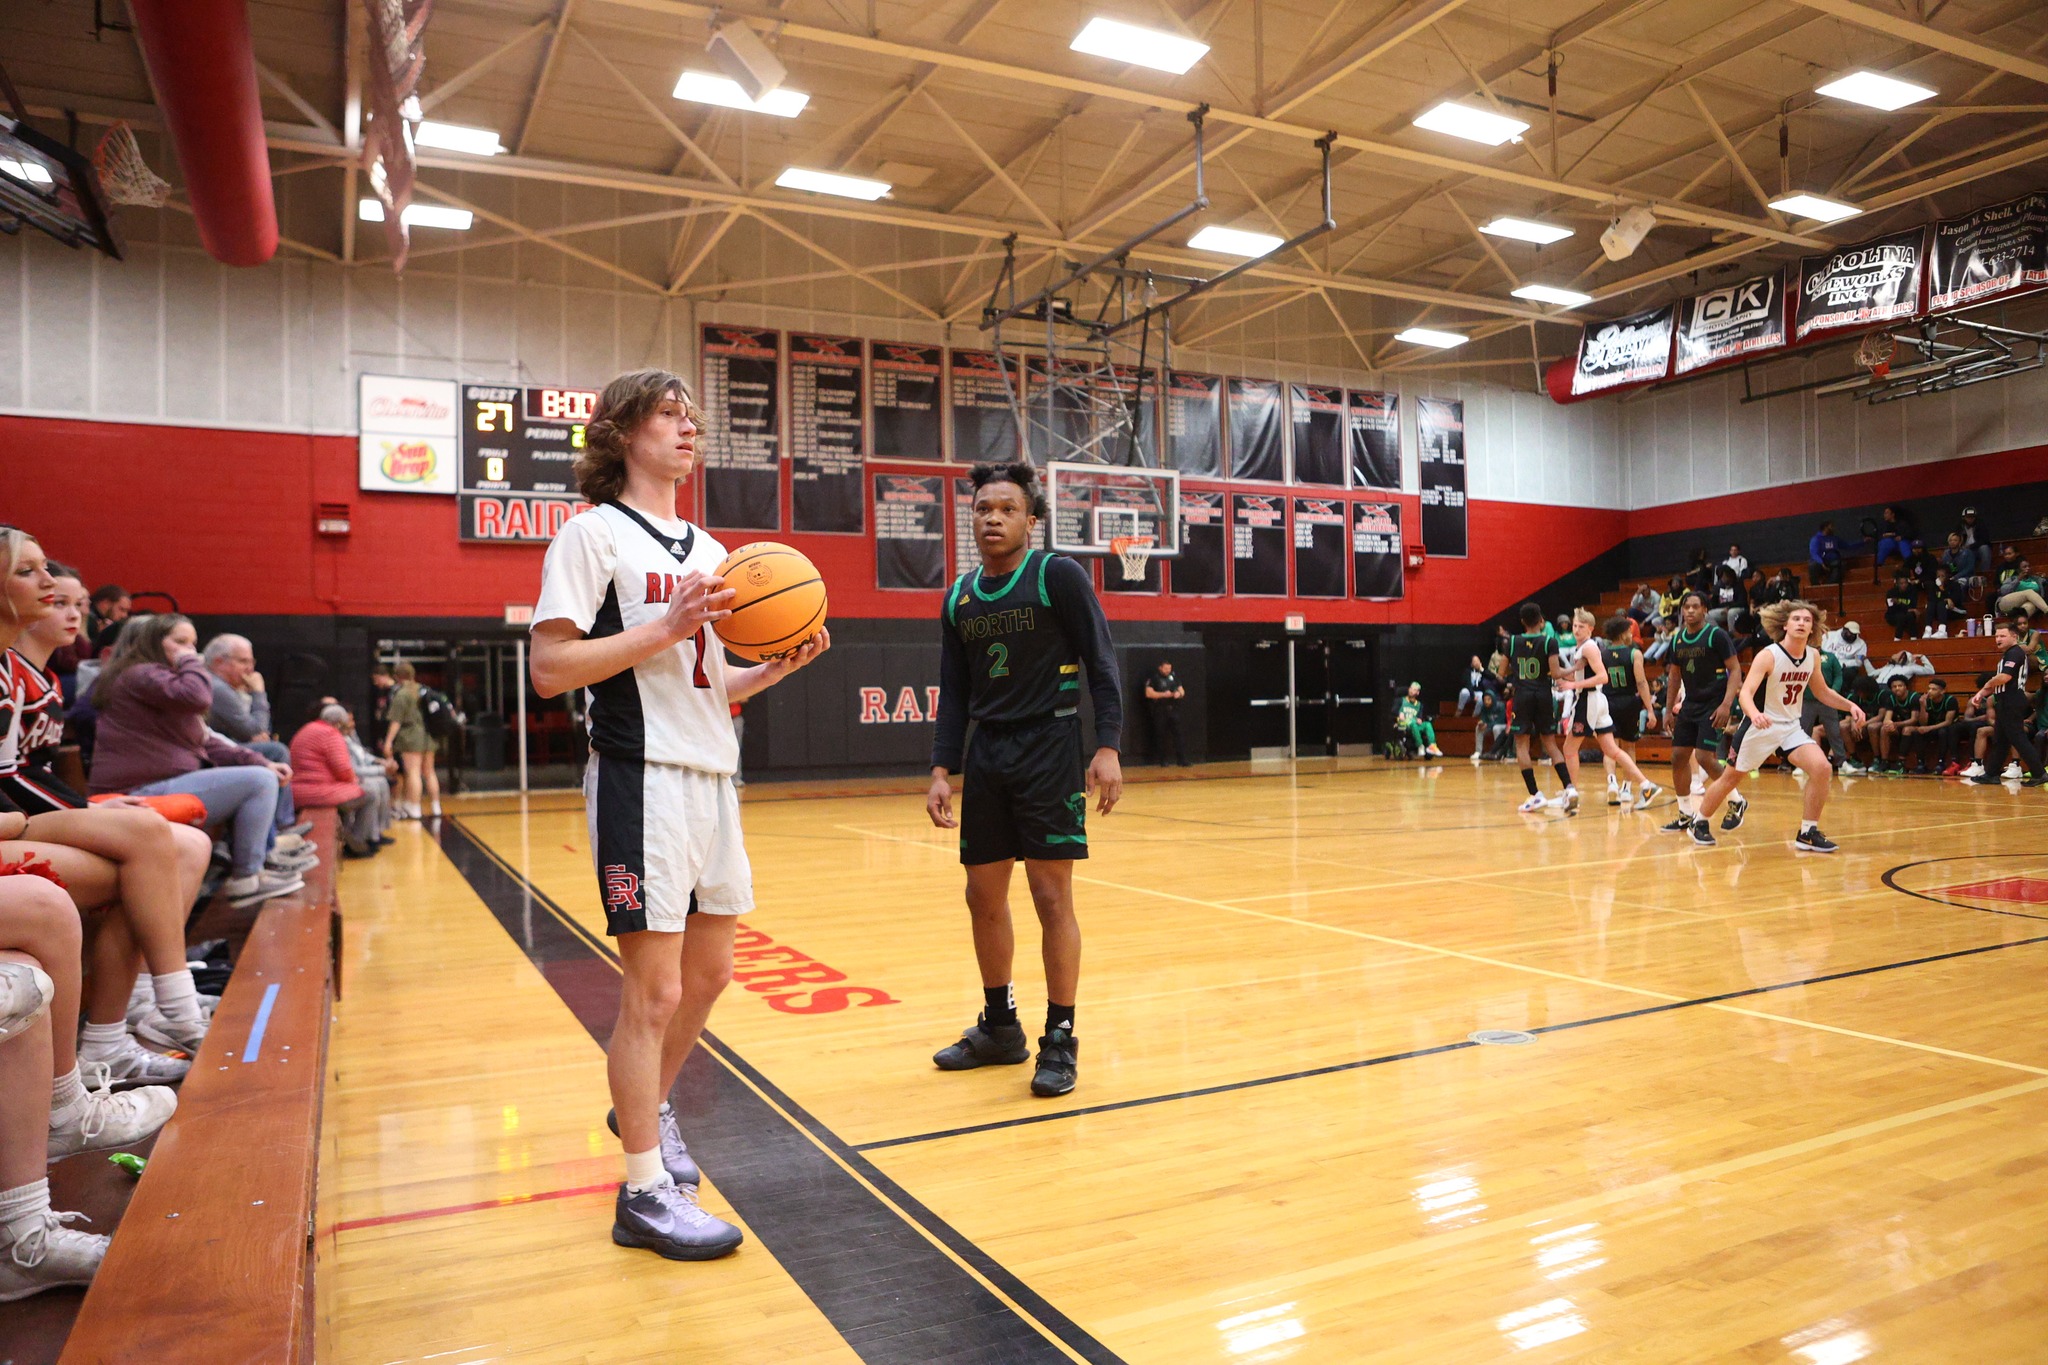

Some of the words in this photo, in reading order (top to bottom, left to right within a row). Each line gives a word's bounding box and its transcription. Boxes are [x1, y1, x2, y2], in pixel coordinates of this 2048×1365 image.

[1940, 224, 1969, 236] Jason
[1960, 276, 1998, 298] SPONSOR
[1999, 274, 2011, 286] OF
[1702, 282, 1762, 321] CK
[1742, 333, 1781, 350] ATHLETICS
[467, 386, 518, 401] GUEST
[541, 389, 597, 420] 8:00
[476, 401, 514, 433] 27
[525, 427, 569, 441] PERIOD
[389, 450, 430, 479] Drop
[487, 457, 504, 481] 0
[960, 607, 1035, 642] NORTH
[986, 642, 1010, 679] 2
[1517, 657, 1541, 681] 10
[1686, 659, 1696, 674] 4
[1607, 666, 1628, 689] 11
